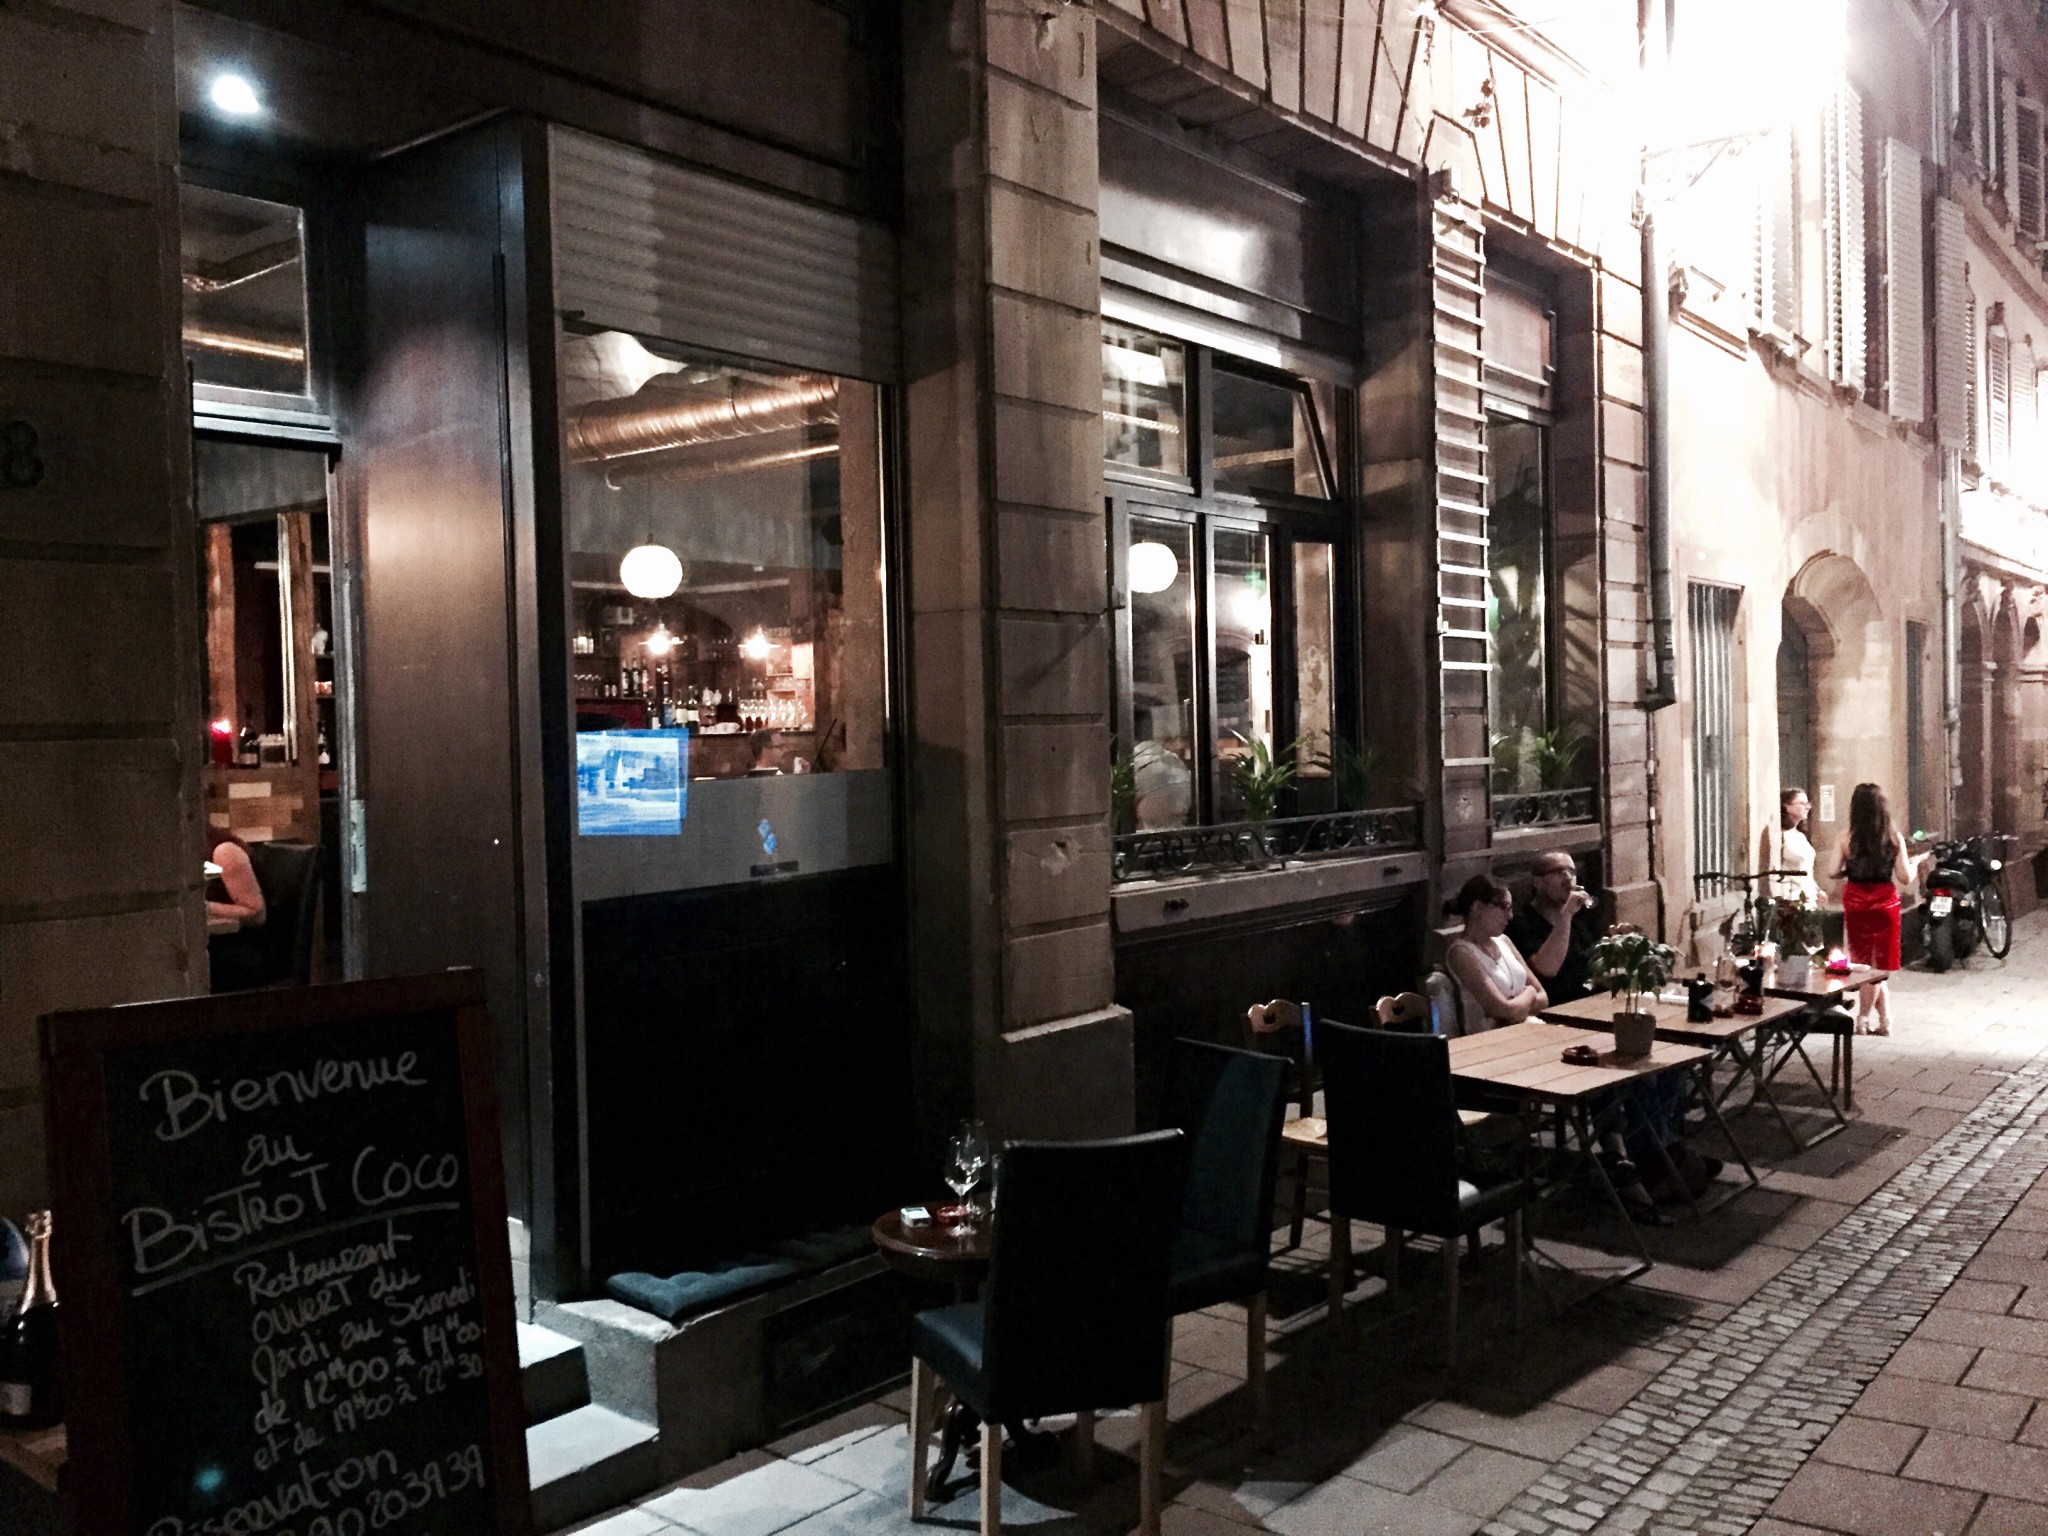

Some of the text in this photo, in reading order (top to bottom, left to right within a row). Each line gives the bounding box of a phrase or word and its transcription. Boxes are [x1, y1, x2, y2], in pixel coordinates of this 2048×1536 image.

[139, 1049, 429, 1142] Bienvenue
[241, 1133, 314, 1177] au
[338, 1316, 384, 1351] au
[384, 1264, 477, 1327] Samedi
[369, 1265, 422, 1299] du
[254, 1389, 292, 1436] de
[392, 1336, 417, 1368] à
[253, 1432, 291, 1471] et
[294, 1420, 326, 1455] de
